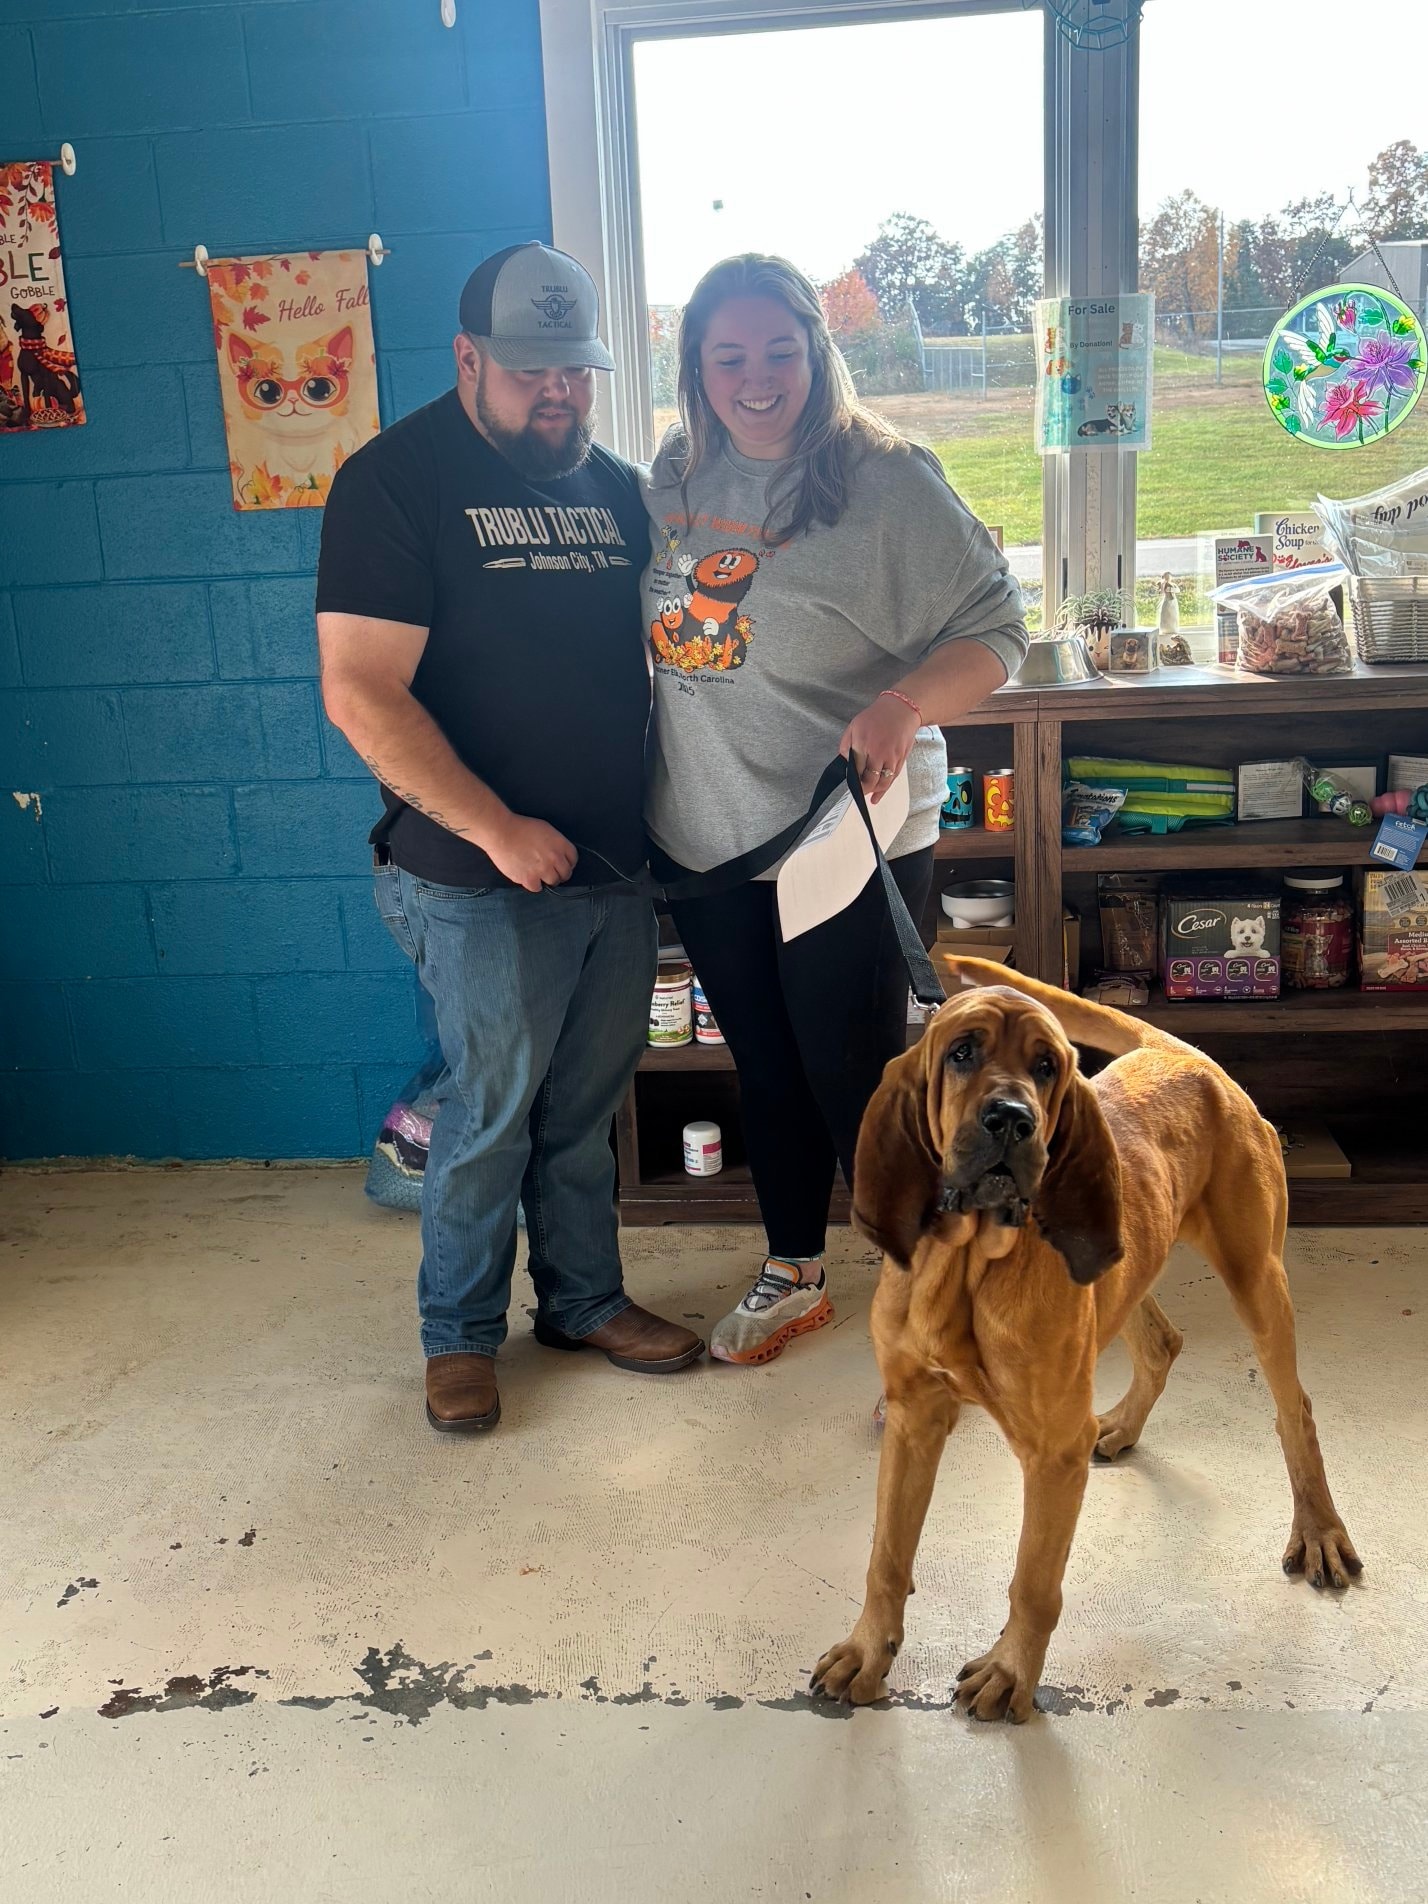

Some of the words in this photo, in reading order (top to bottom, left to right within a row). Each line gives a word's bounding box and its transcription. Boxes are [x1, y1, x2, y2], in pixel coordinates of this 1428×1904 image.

[11, 286, 55, 299] GOBBLE
[278, 299, 326, 322] Hello
[335, 285, 370, 313] Fall
[1068, 305, 1088, 316] For
[1090, 303, 1115, 315] Sale
[537, 321, 573, 329] TACTICAL
[1079, 340, 1113, 348] Donation!
[464, 508, 550, 548] TRUBLU
[545, 506, 626, 547] TACTICAL
[1275, 535, 1304, 550] Soup
[1217, 545, 1255, 554] HUMANE
[529, 551, 571, 570] Johnson
[570, 551, 595, 573] City,
[591, 550, 609, 568] TN
[1217, 552, 1254, 562] SOCIETY
[700, 674, 735, 685] Carolina
[1177, 914, 1221, 934] Cesar
